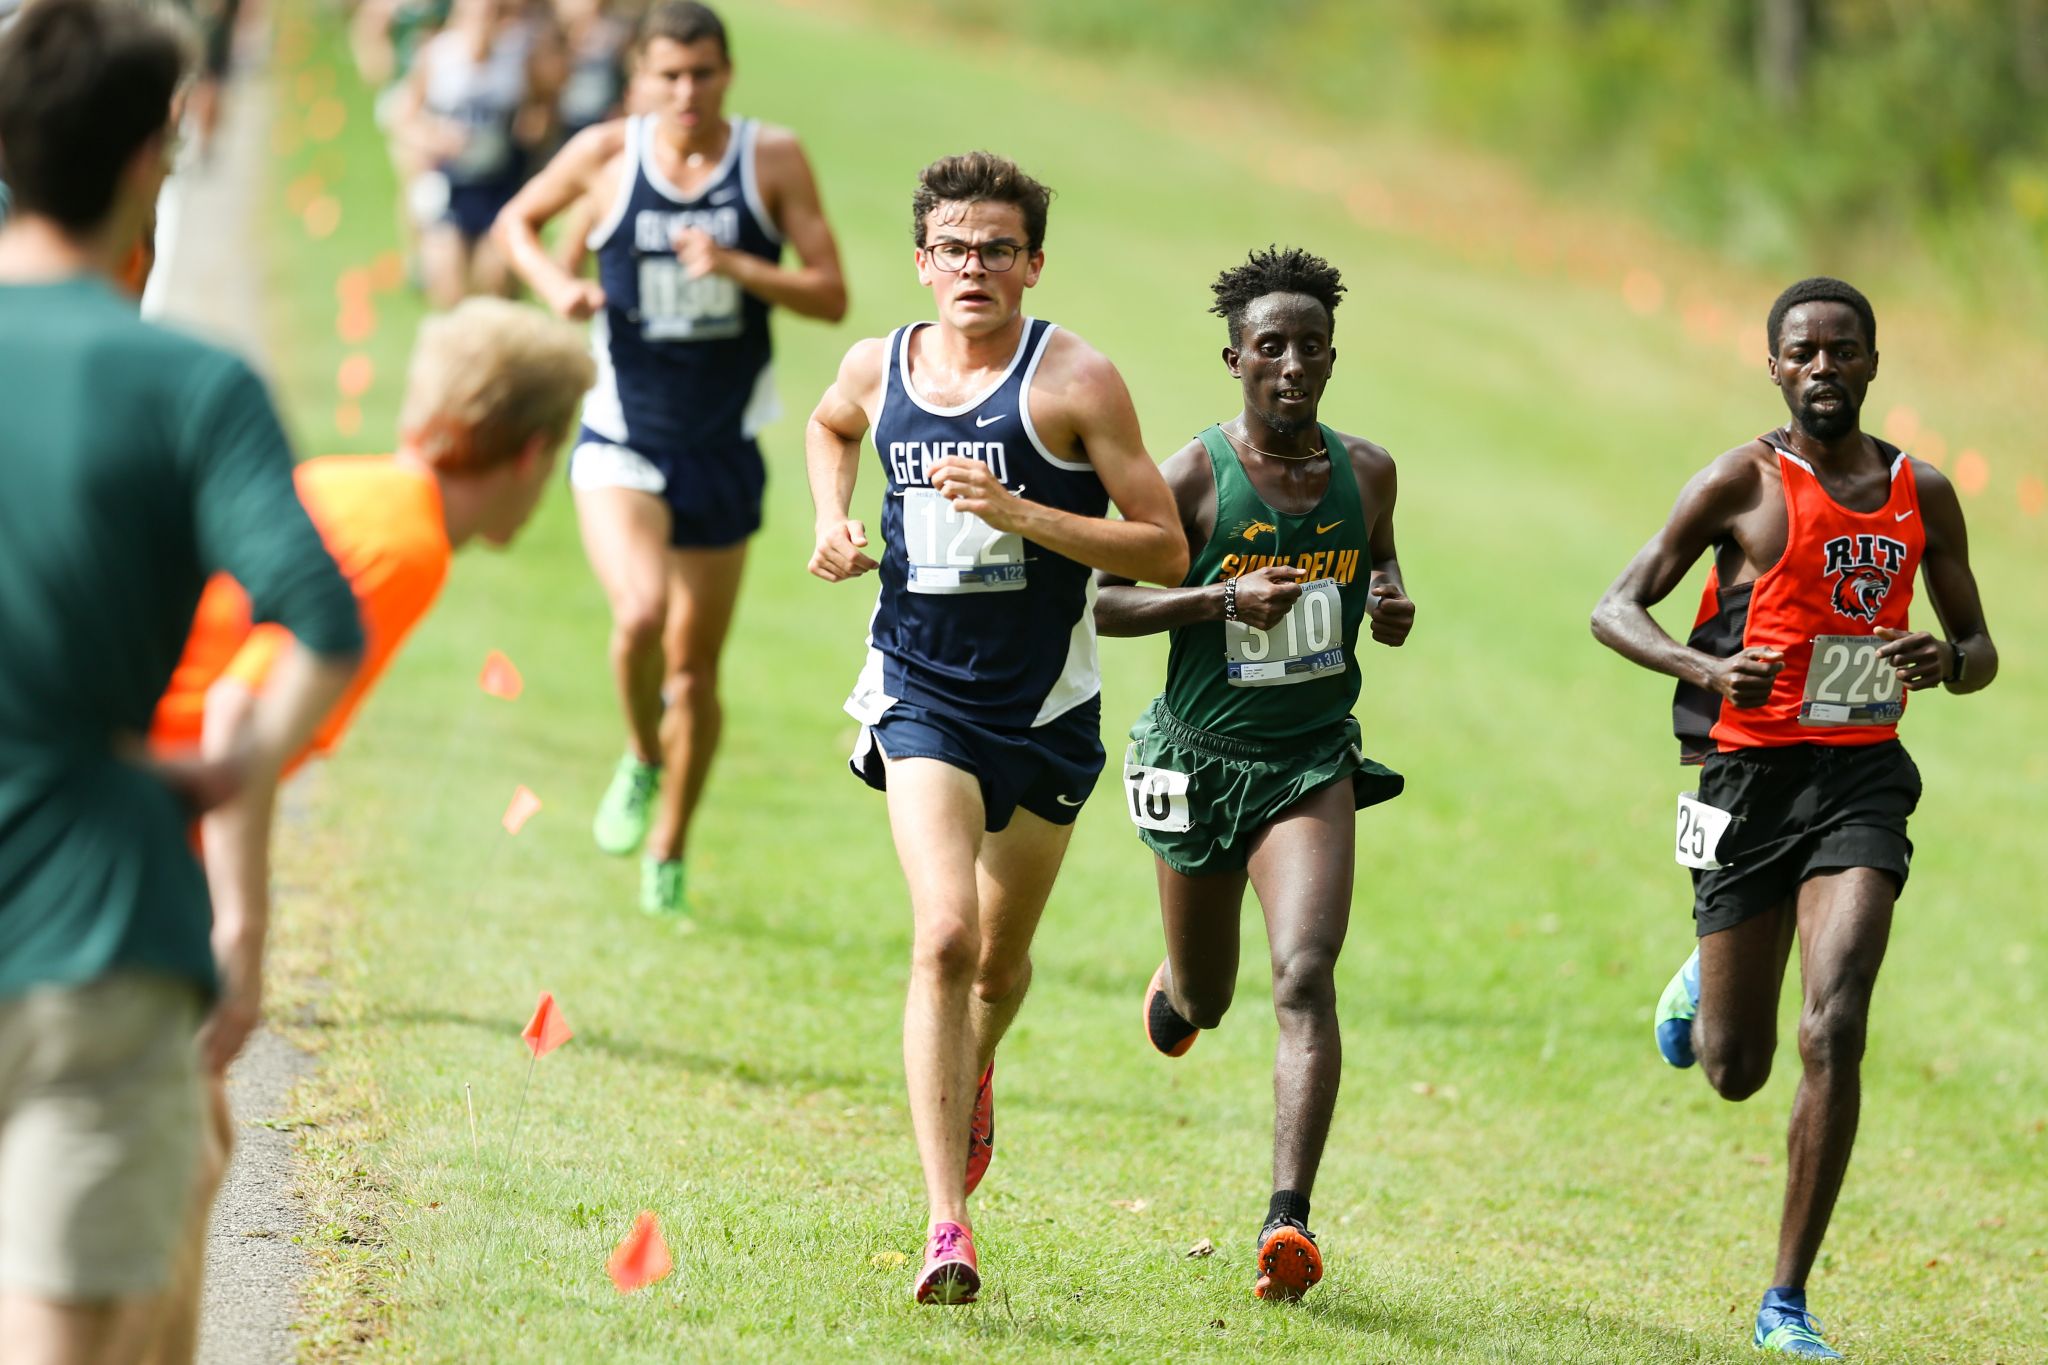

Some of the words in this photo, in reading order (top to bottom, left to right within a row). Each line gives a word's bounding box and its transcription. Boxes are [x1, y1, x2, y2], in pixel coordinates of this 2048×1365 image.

[1002, 566, 1025, 581] 122
[1295, 549, 1360, 584] DELHI
[1823, 534, 1907, 577] RIT
[1325, 650, 1344, 666] 310
[1816, 644, 1897, 703] 225
[1129, 771, 1171, 821] 10
[1678, 805, 1710, 859] 25
